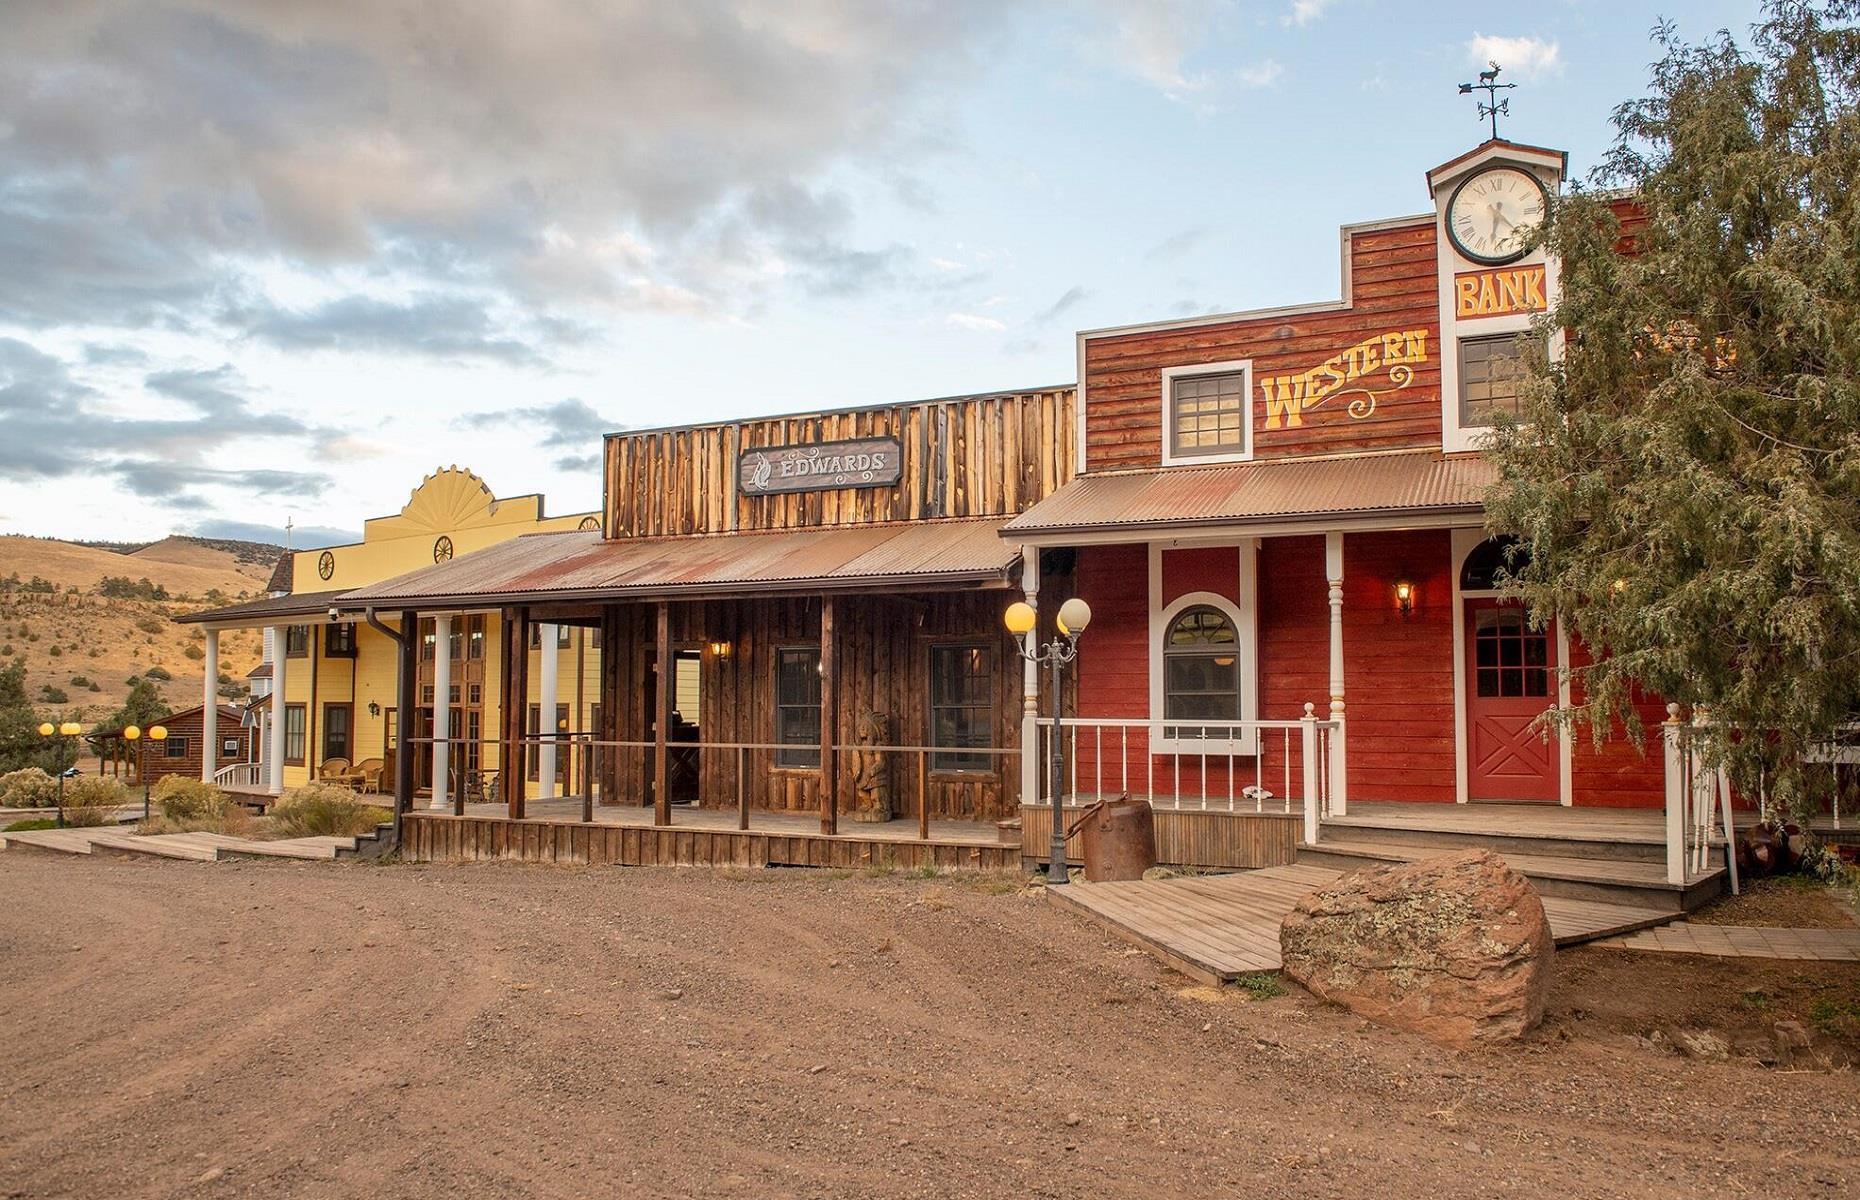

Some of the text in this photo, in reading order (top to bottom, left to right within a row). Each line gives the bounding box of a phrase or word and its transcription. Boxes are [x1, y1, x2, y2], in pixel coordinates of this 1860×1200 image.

[1455, 269, 1546, 317] BANK
[1260, 329, 1429, 430] WESTERN
[780, 452, 886, 477] EDWARDS
